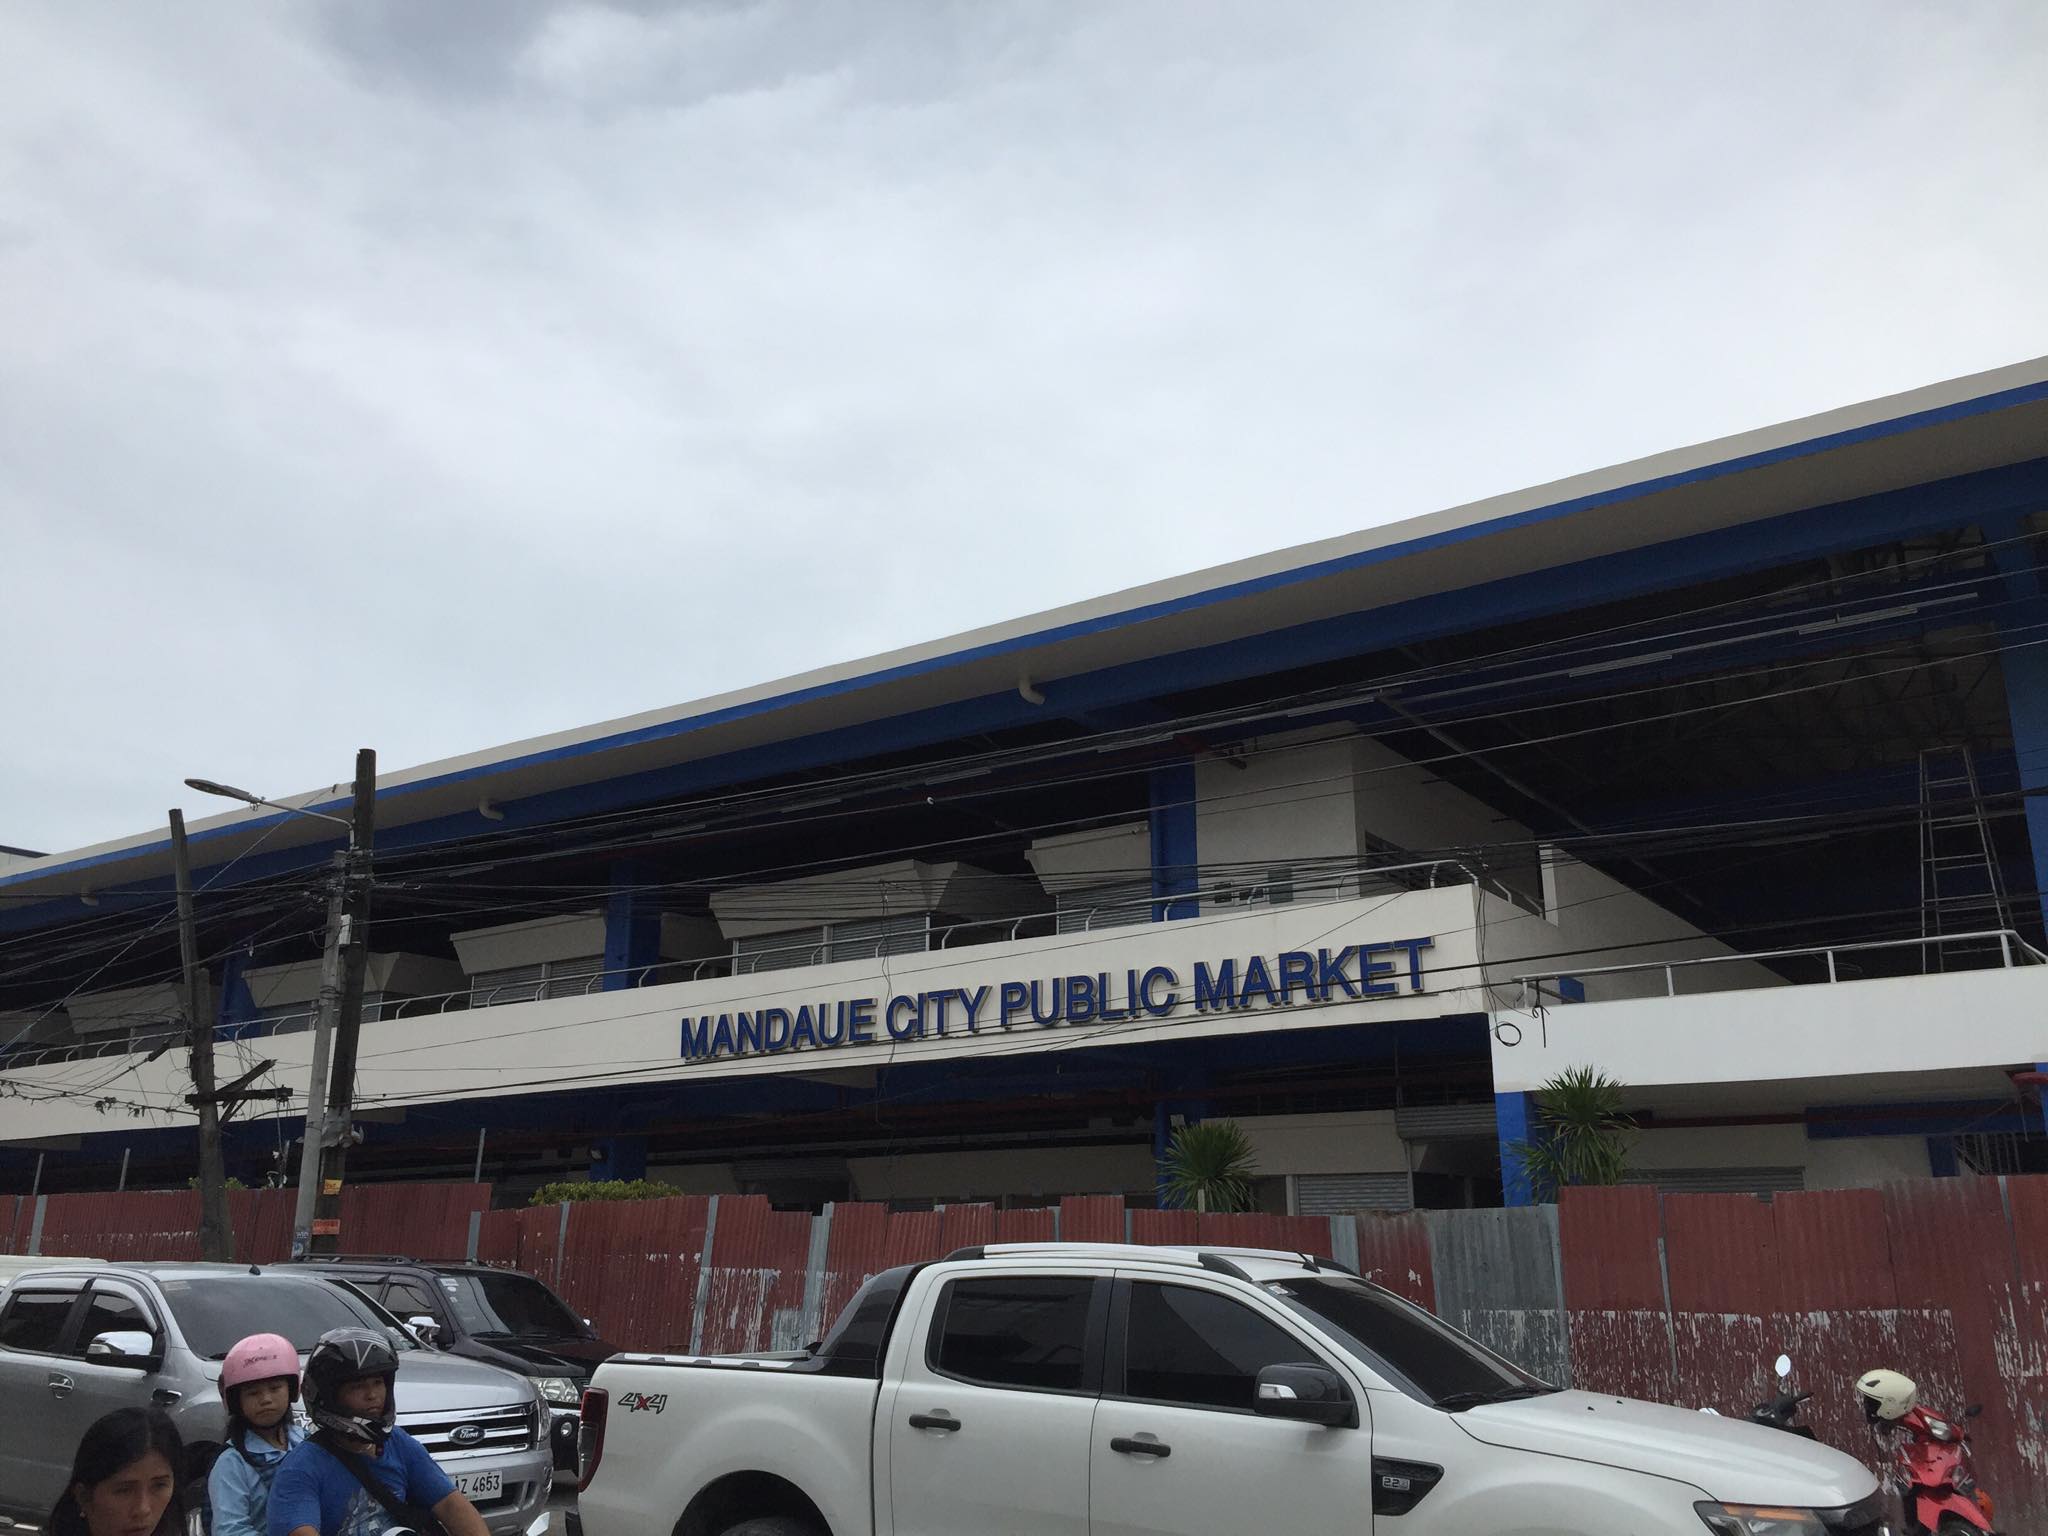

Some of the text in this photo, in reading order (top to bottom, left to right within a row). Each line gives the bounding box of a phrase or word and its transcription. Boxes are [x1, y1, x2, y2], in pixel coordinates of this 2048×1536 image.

[681, 936, 1435, 1060] MANDAUE CITY PUBLIC MARKET
[459, 1427, 479, 1439] Ford
[472, 1475, 500, 1493] 4653
